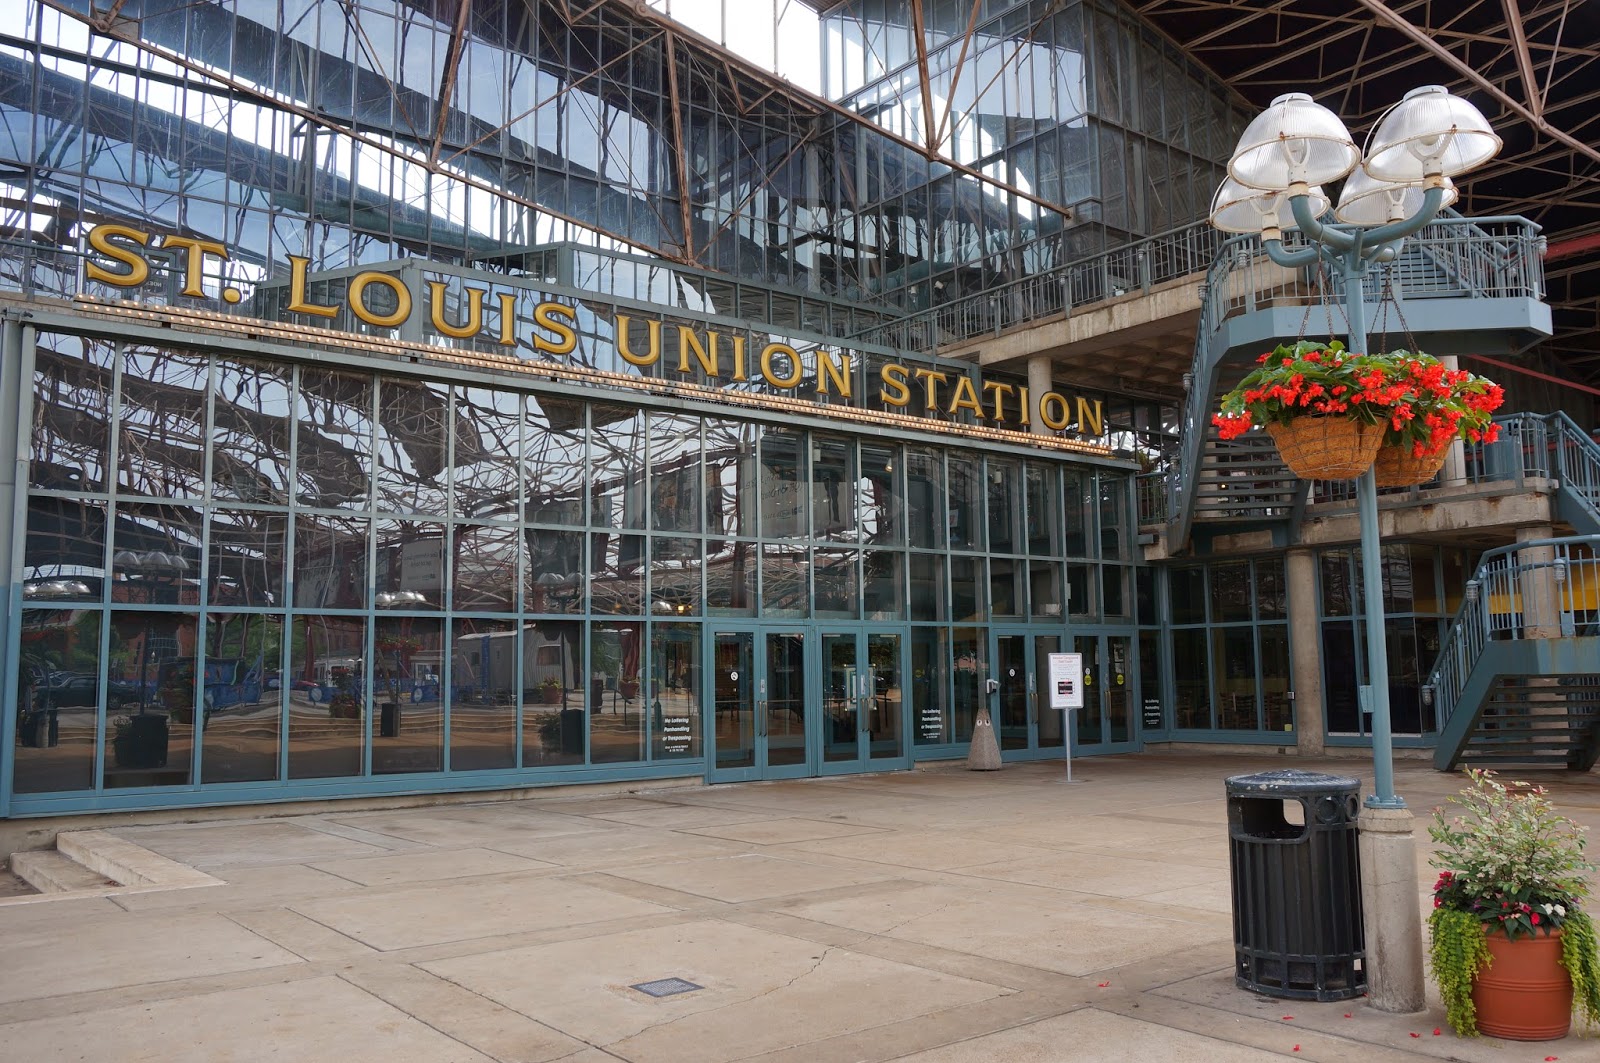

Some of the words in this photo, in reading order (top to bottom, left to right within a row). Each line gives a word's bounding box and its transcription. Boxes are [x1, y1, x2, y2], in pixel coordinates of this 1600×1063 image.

[85, 224, 243, 305] ST.
[285, 254, 577, 355] LOUIS
[615, 314, 853, 399] UNION
[880, 363, 1104, 437] STATION
